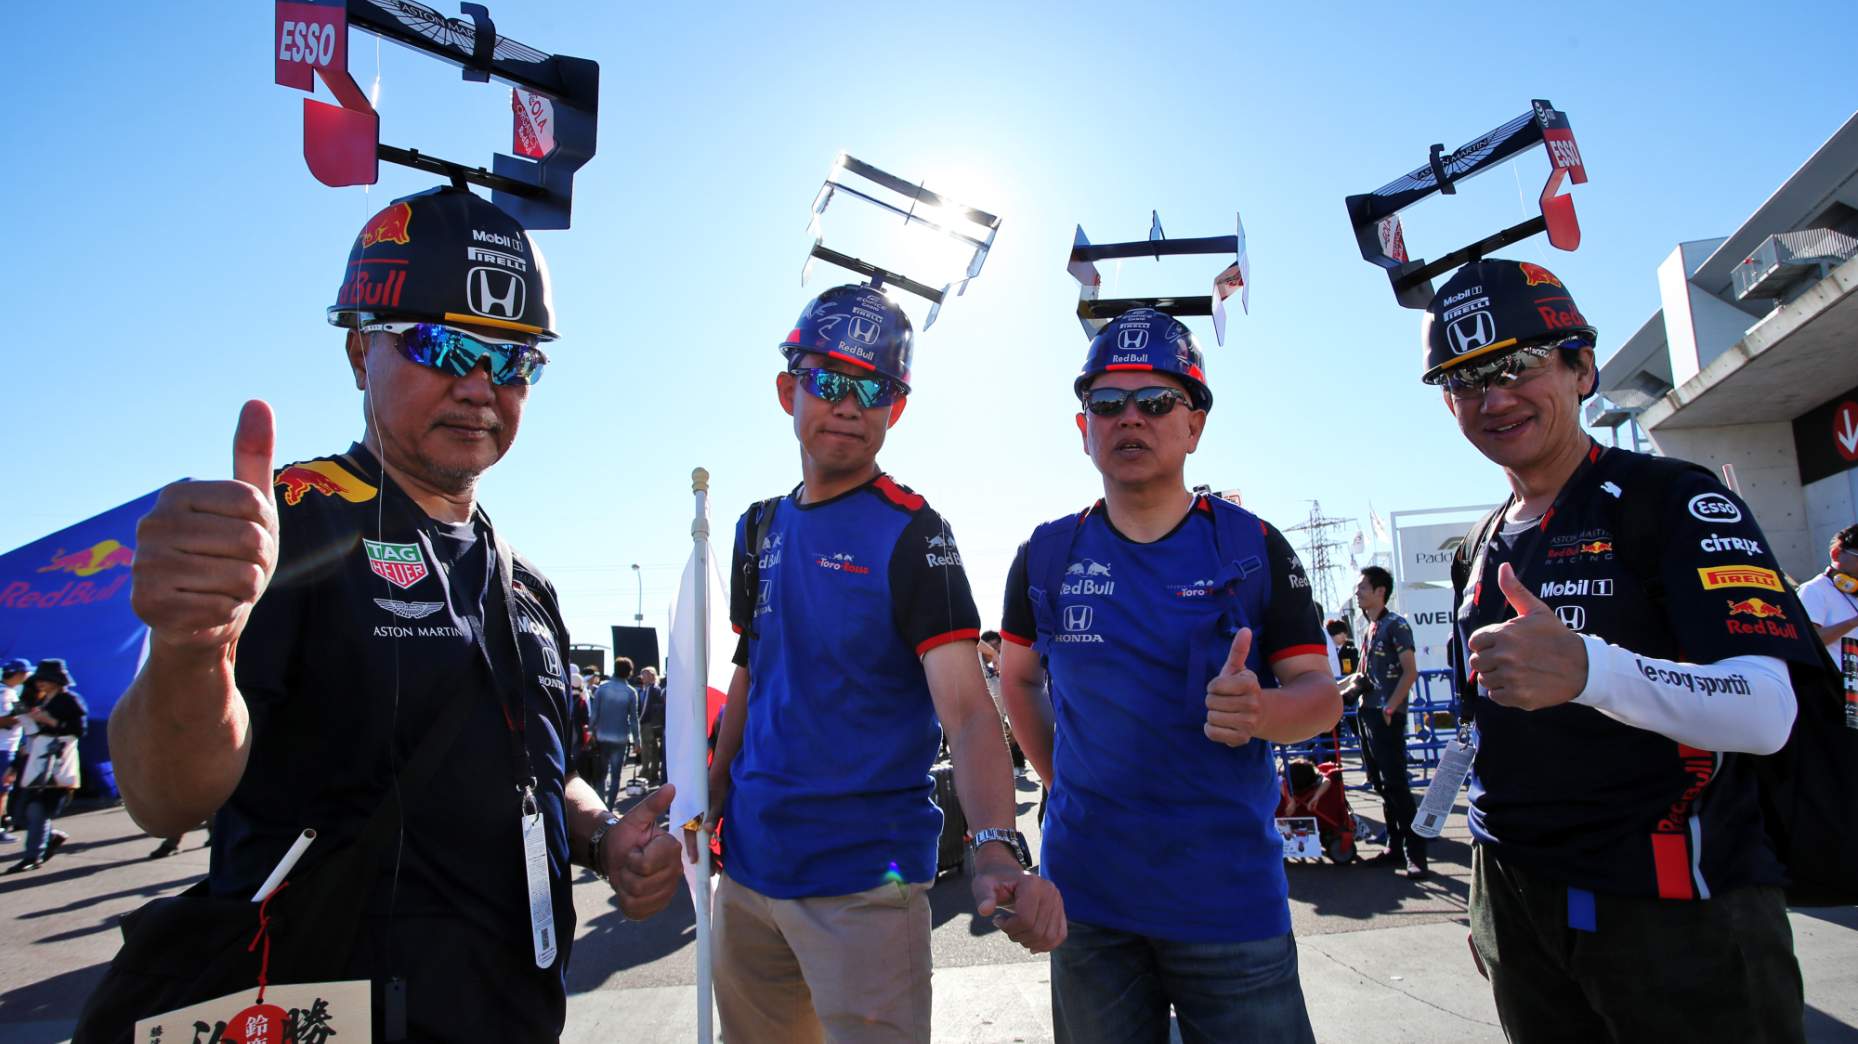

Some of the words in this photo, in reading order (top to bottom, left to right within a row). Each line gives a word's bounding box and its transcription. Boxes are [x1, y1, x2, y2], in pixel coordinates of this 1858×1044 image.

[402, 4, 446, 28] ASTON
[447, 22, 476, 39] MAR
[280, 21, 336, 66] ESSO
[1549, 140, 1581, 167] ESSO
[473, 230, 510, 247] Mobil
[468, 247, 527, 272] PIRELLI
[351, 270, 407, 307] Bull
[1443, 290, 1470, 307] Mobil
[1443, 297, 1490, 321] PIRELLI
[1538, 304, 1583, 329] Red
[367, 543, 418, 561] TAG
[926, 552, 954, 567] Red
[1416, 551, 1454, 564] Padd
[820, 557, 841, 570] Toro
[370, 561, 427, 586] HEUER
[1706, 569, 1777, 588] PIRELLI
[1084, 579, 1116, 596] Bull
[1540, 579, 1590, 598] Mobil
[373, 626, 414, 638] ASTON
[418, 626, 463, 638] MARTIN
[1055, 634, 1104, 643] HONDA
[1726, 619, 1767, 635] Red
[1766, 619, 1799, 640] Bull
